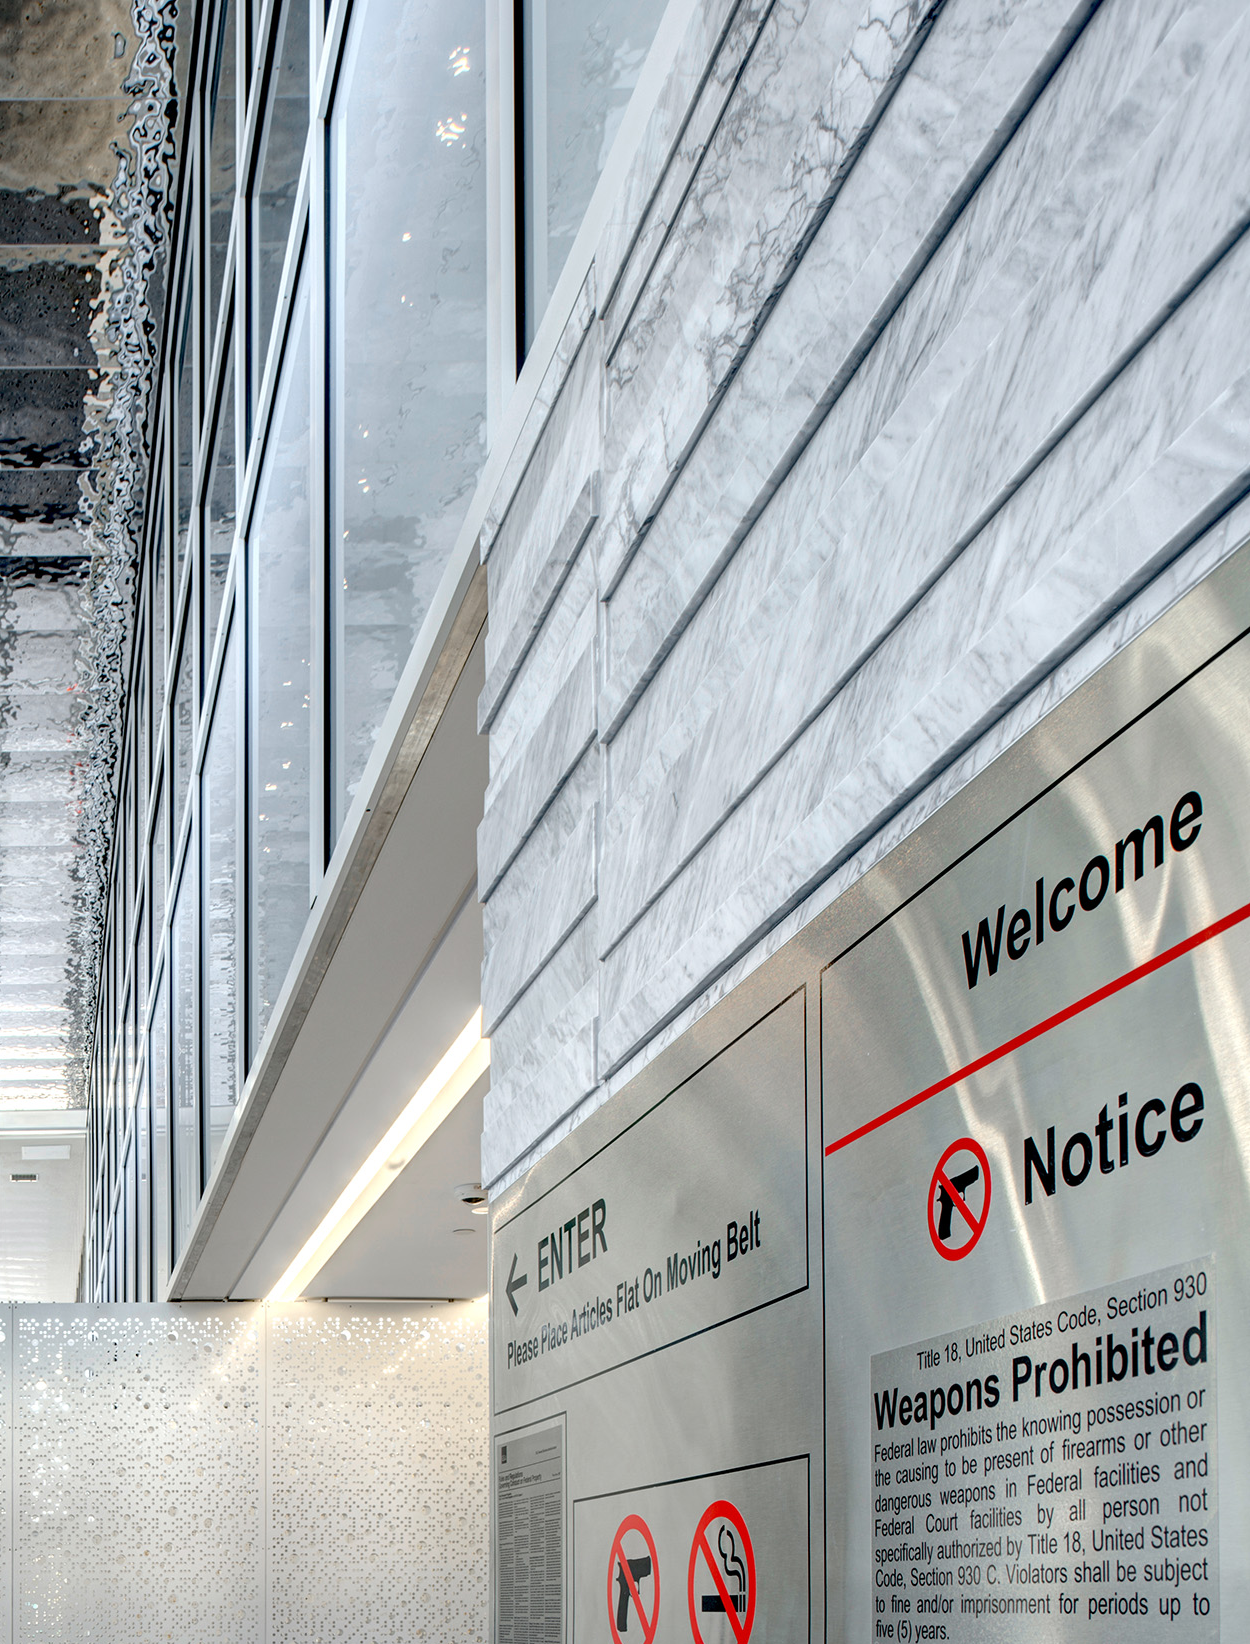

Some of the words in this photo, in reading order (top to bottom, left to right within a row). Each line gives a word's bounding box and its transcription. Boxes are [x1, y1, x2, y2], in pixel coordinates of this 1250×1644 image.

[962, 788, 1203, 990] Welcome
[1024, 1082, 1204, 1206] Notice
[538, 1198, 607, 1292] ENTER
[508, 1337, 538, 1369] Please
[542, 1323, 567, 1354] Place
[571, 1297, 612, 1340] Articles
[617, 1277, 639, 1317] Flat
[643, 1268, 662, 1303] On
[667, 1239, 721, 1292] Moving
[727, 1209, 760, 1262] Belt
[917, 1349, 940, 1370] Title
[945, 1342, 961, 1363] 18,
[966, 1328, 1005, 1357] United
[1010, 1321, 1052, 1345] States
[1057, 1305, 1100, 1333] Code,
[1107, 1288, 1167, 1319] Section
[1174, 1272, 1207, 1302] 930
[874, 1374, 1000, 1431] Weapons
[1012, 1311, 1207, 1402] Prohibited
[875, 1438, 914, 1463] Federal
[918, 1437, 937, 1455] law
[941, 1425, 992, 1456] prohibits
[996, 1421, 1017, 1442] the
[1022, 1410, 1081, 1437] knowing
[1087, 1392, 1180, 1426] possession
[1187, 1389, 1206, 1409] or
[875, 1469, 891, 1487] the
[896, 1462, 938, 1484] causing
[945, 1459, 956, 1477] to
[962, 1456, 977, 1475] be
[984, 1446, 1034, 1477] present
[1041, 1441, 1054, 1463] of
[1062, 1436, 1125, 1460] firearms
[1134, 1432, 1151, 1450] or
[1160, 1421, 1207, 1447] other
[875, 1492, 932, 1515] dangerous
[940, 1485, 995, 1511] weapons
[1006, 1478, 1016, 1498] in
[1028, 1468, 1082, 1495] Federal
[1094, 1461, 1160, 1488] facilities
[1174, 1452, 1208, 1480] and
[875, 1516, 914, 1538] Federal
[926, 1512, 958, 1533] Court
[970, 1507, 1022, 1529] facilities
[1038, 1503, 1054, 1529] by
[1069, 1499, 1085, 1521] all
[1103, 1497, 1159, 1524] person
[1179, 1488, 1208, 1512] not
[875, 1542, 933, 1567] specifically
[937, 1537, 1001, 1560] authorized
[1007, 1536, 1022, 1561] by
[1027, 1533, 1057, 1554] Title
[1064, 1531, 1085, 1556] 18,
[1093, 1527, 1144, 1552] United
[1151, 1525, 1208, 1549] States
[876, 1568, 906, 1590] Code,
[911, 1567, 953, 1587] Section
[958, 1565, 981, 1585] 930
[987, 1564, 1000, 1585] C.
[1006, 1563, 1067, 1584] Violators
[1074, 1560, 1109, 1583] shall
[1117, 1560, 1136, 1582] be
[1144, 1557, 1208, 1587] subject
[875, 1596, 885, 1613] to
[891, 1594, 911, 1613] fine
[917, 1594, 954, 1613] and/or
[961, 1594, 1050, 1618] imprisonment
[1058, 1593, 1079, 1614] for
[1089, 1592, 1148, 1620] periods
[1159, 1597, 1181, 1621] up
[1193, 1592, 1210, 1616] to
[876, 1619, 894, 1638] five
[897, 1620, 912, 1643] (5)
[915, 1625, 949, 1644] years.
